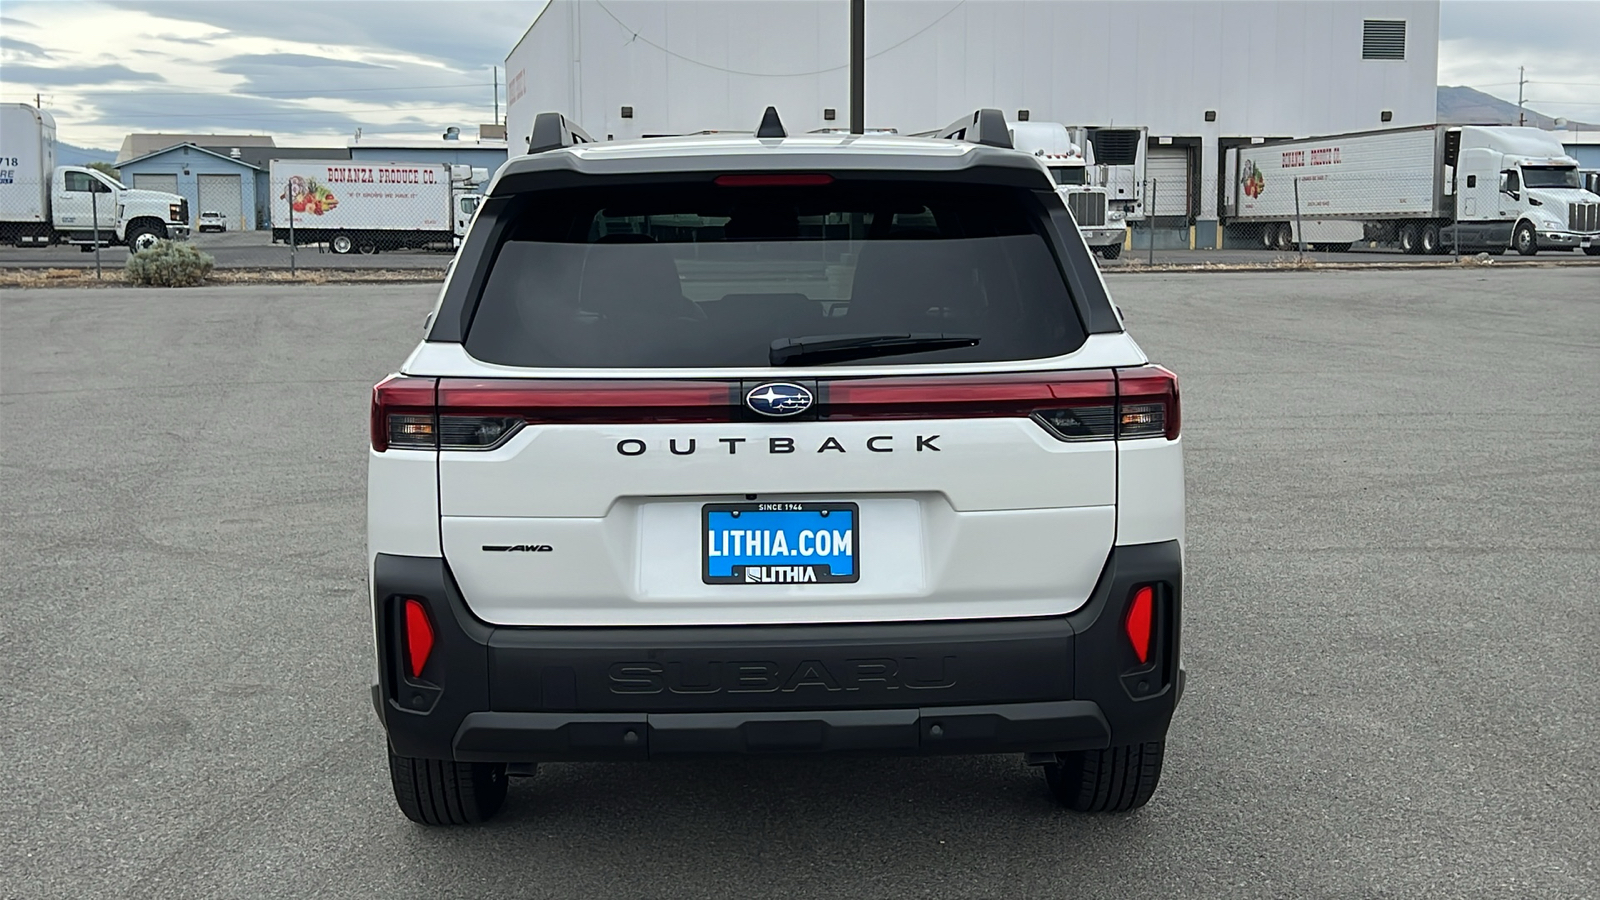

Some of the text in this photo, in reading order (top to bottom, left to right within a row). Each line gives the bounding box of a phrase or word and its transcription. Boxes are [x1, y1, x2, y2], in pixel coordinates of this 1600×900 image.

[327, 167, 437, 185] BONANZA PRODUCE CO.
[616, 435, 941, 456] OUTBACK
[508, 544, 553, 552] AWD
[708, 529, 853, 557] LITHIA.COM
[761, 566, 817, 583] LITHIA
[608, 656, 957, 694] SUBARU
